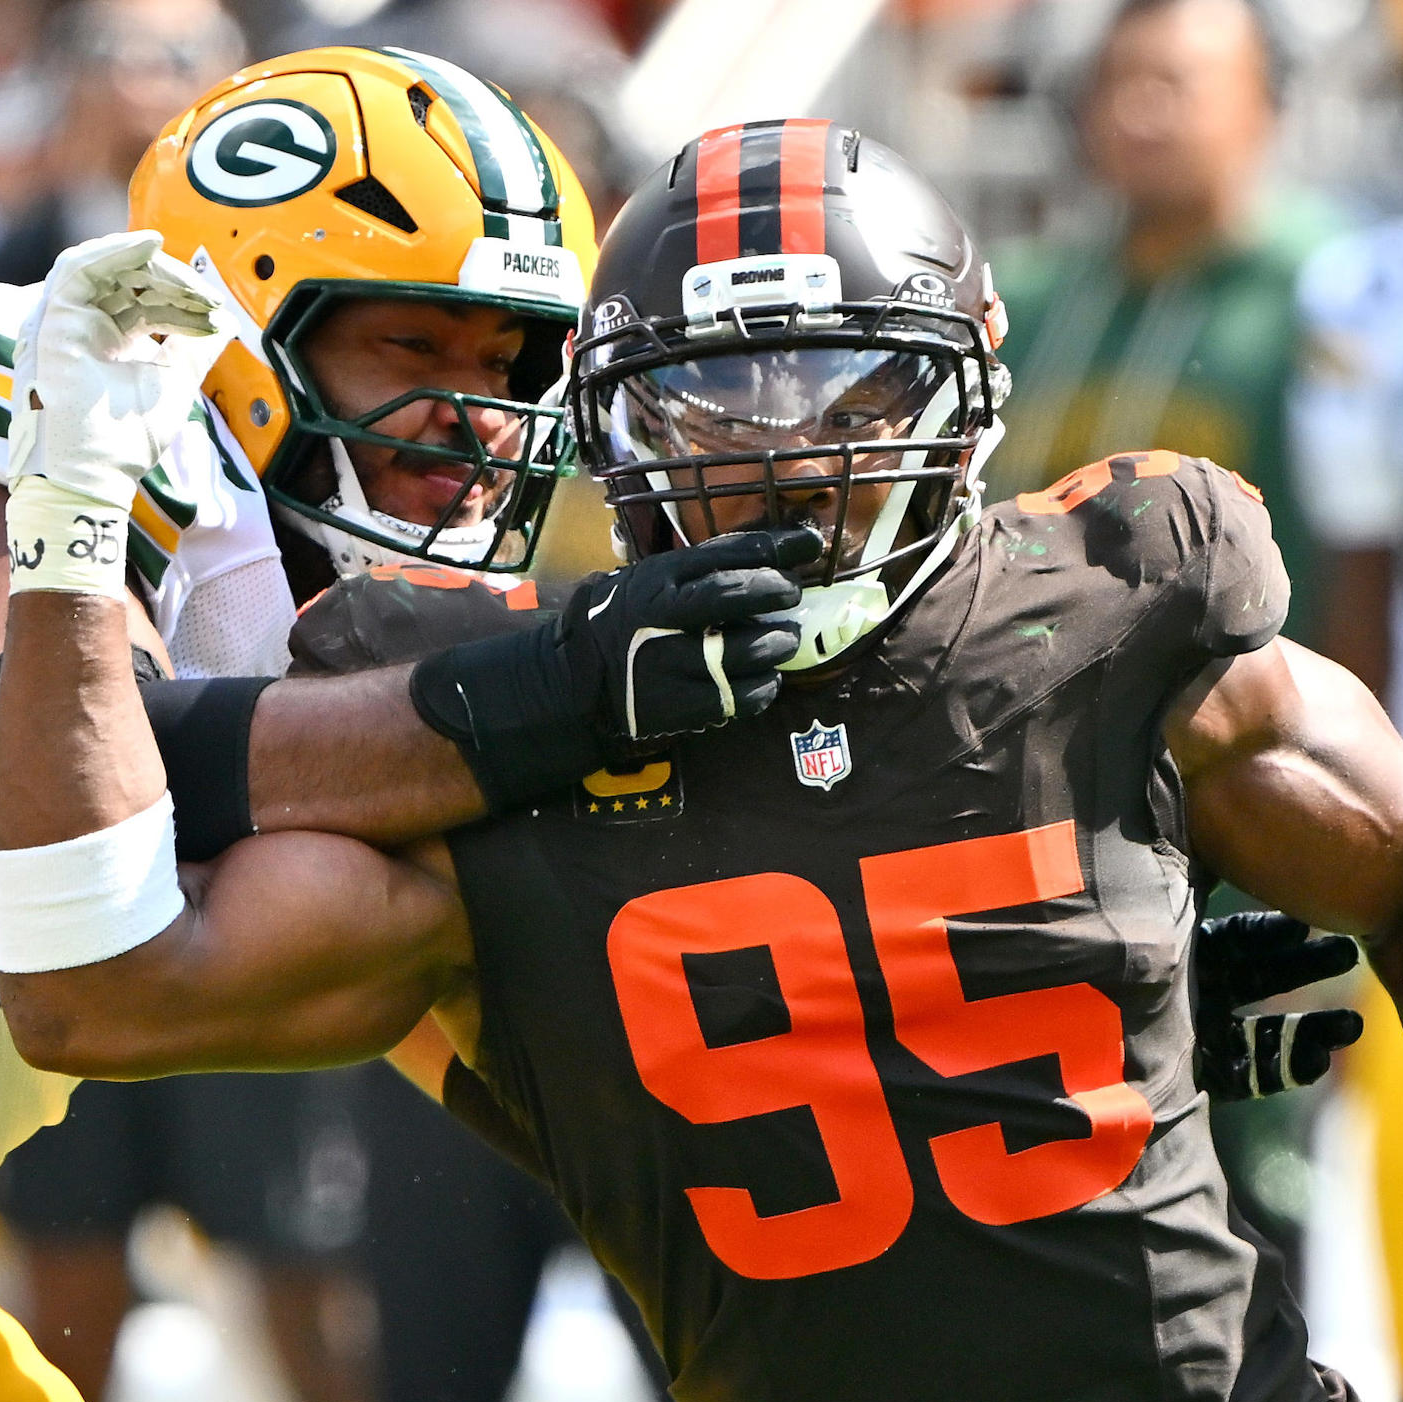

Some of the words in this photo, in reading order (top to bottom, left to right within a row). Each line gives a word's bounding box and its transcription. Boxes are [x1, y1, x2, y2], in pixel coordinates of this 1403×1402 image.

[191, 102, 330, 201] G
[504, 252, 560, 278] PACKERS
[731, 268, 785, 286] BROWNS
[901, 290, 955, 308] OAKLEY
[67, 514, 118, 565] 25
[802, 750, 842, 777] NFL
[606, 818, 1155, 1281] 95
